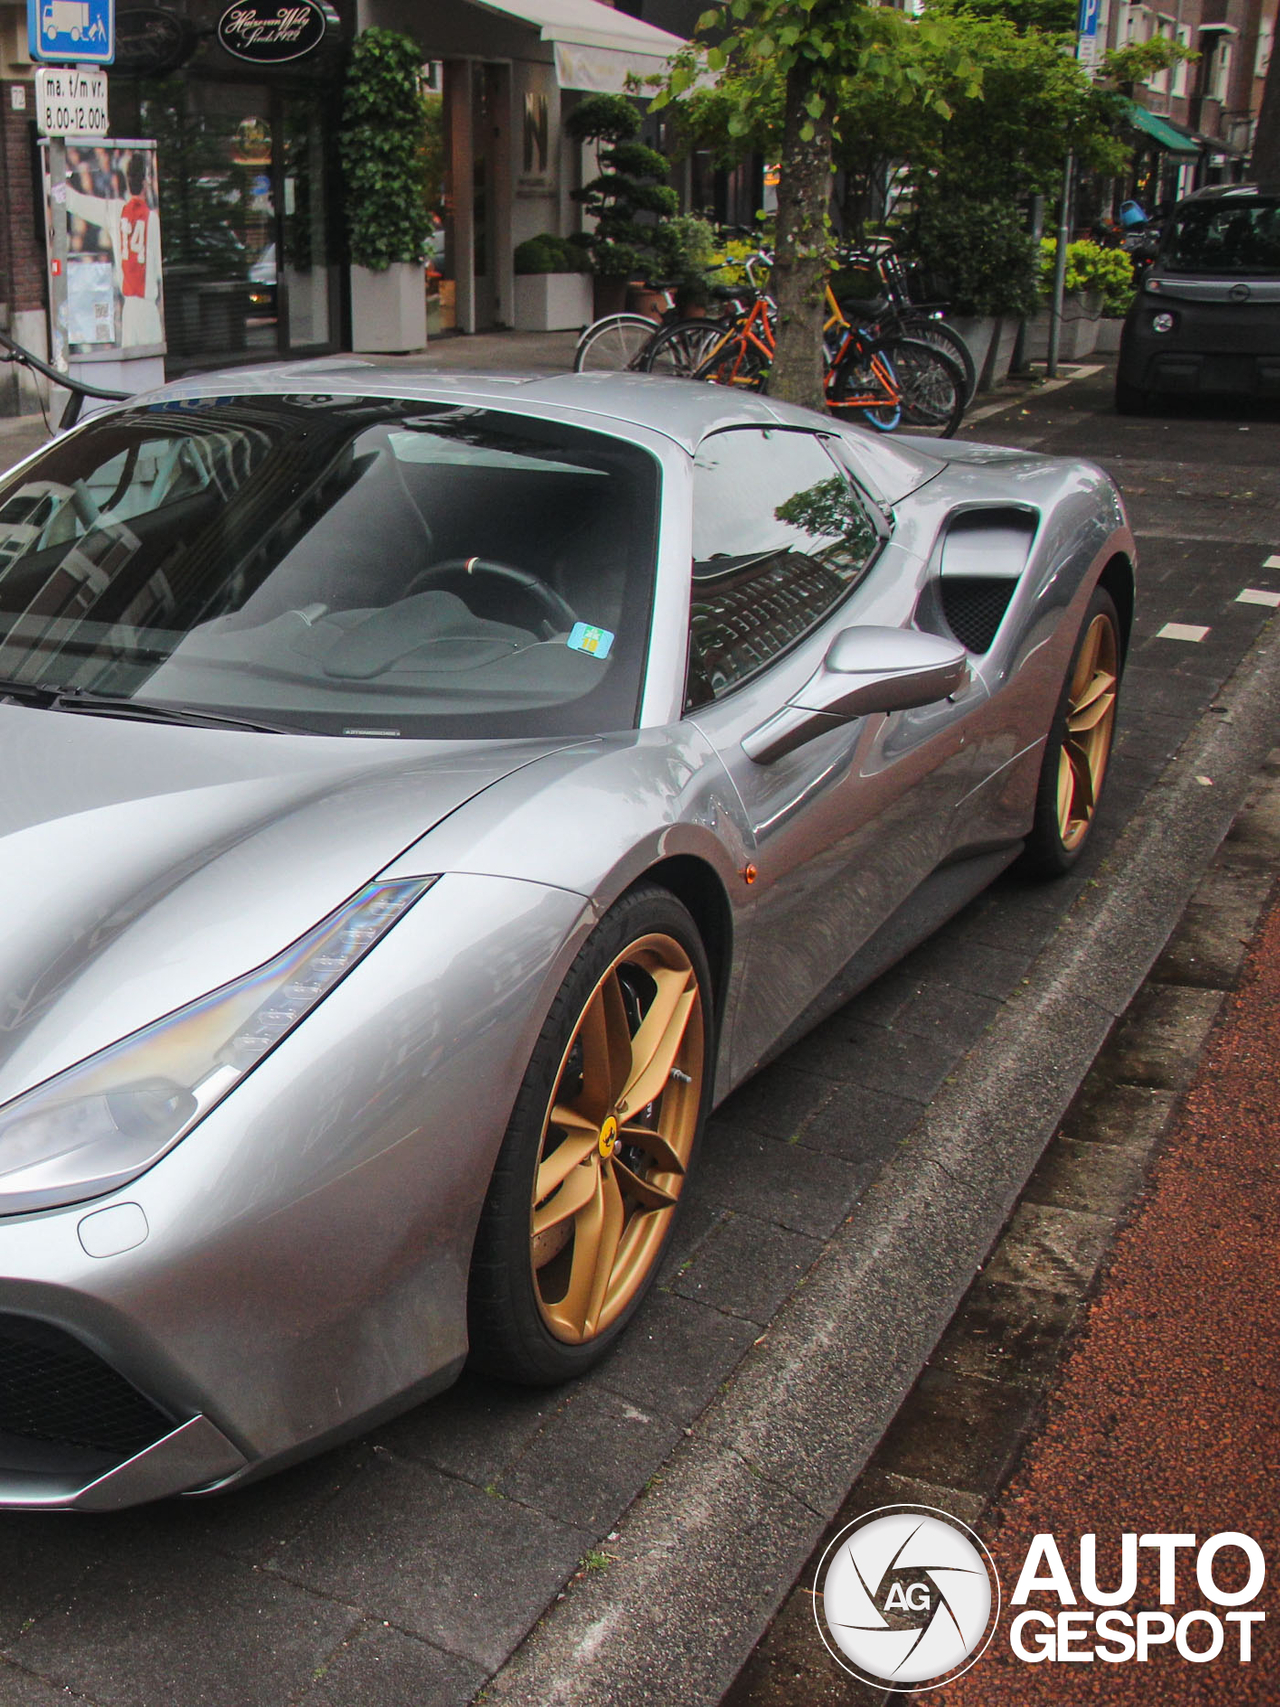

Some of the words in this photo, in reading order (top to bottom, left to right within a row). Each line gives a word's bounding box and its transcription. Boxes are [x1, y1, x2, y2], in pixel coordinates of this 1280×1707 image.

[47, 80, 65, 97] ma.
[69, 73, 88, 98] t/m
[92, 81, 104, 97] vr.
[46, 107, 106, 129] 8.00-12.00h
[121, 217, 145, 264] 14
